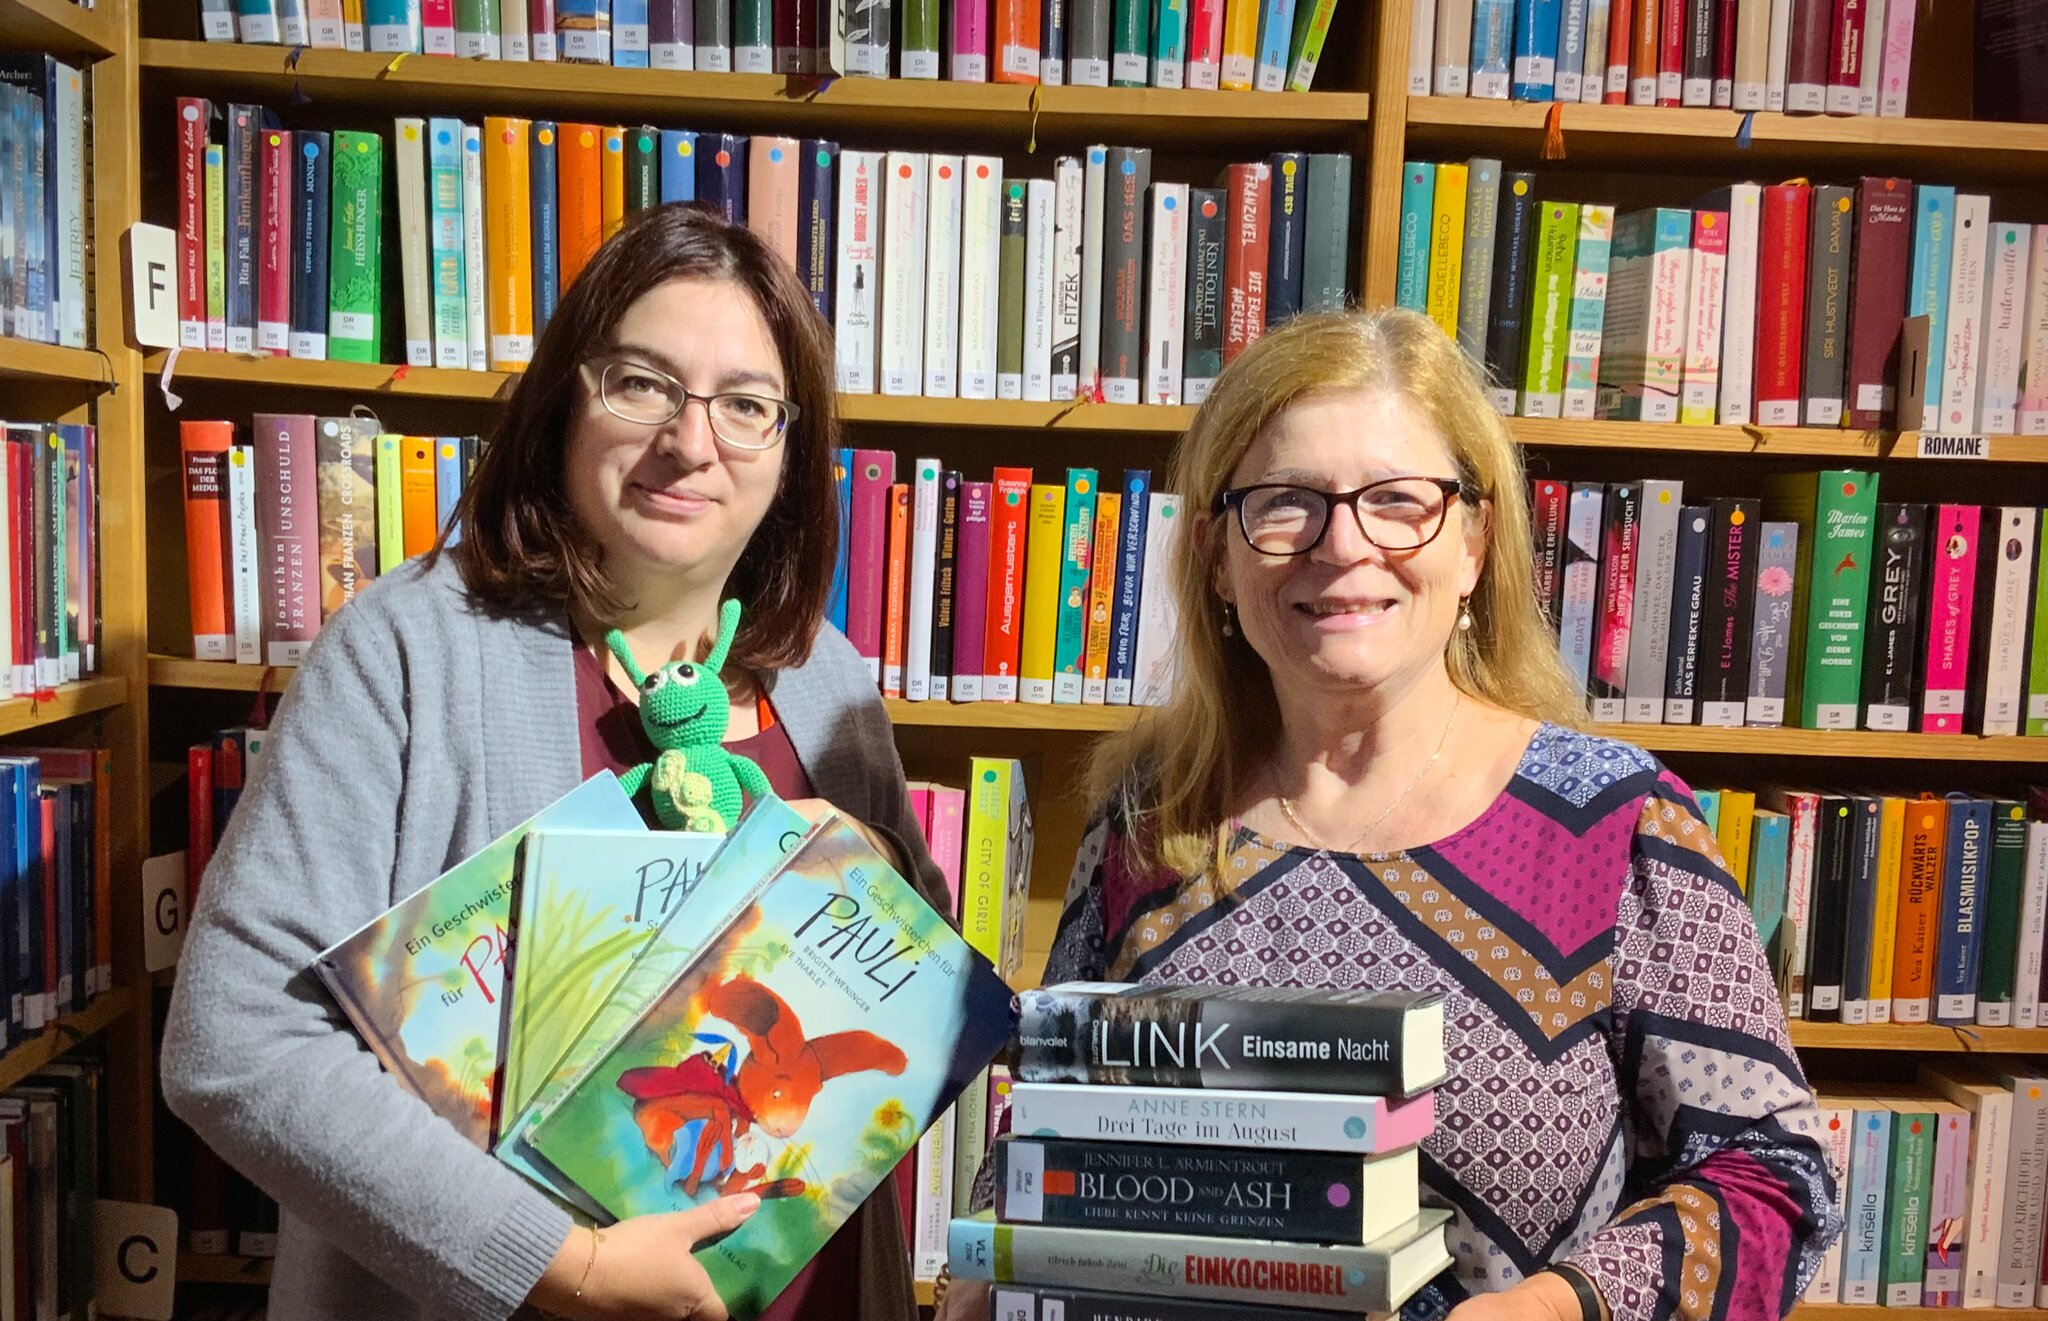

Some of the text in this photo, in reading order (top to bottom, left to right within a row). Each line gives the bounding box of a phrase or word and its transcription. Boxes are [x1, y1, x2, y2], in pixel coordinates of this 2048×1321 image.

[185, 122, 195, 150] Leben
[186, 153, 194, 170] das
[186, 172, 197, 200] spielt
[306, 157, 315, 193] MONDE
[187, 203, 199, 242] Johanna
[238, 128, 252, 285] Rita Falk Funkenflieger
[355, 188, 367, 267] HEISSHUNGER
[854, 178, 868, 242] BRIDGET JONES
[1122, 211, 1133, 243] DAS
[1241, 173, 1258, 246] FRANZOBEL
[1284, 195, 1293, 215] 438
[1470, 186, 1482, 238] PASCALE
[1480, 186, 1494, 238] HUGUES
[69, 211, 82, 281] JEFFREY
[1401, 212, 1418, 306] HOUELLEBECQ
[1436, 213, 1451, 307] HOUELLEBECQ
[1958, 235, 1968, 280] HIMMEL
[148, 261, 166, 310] F
[189, 267, 197, 302] SUSANNE
[1194, 228, 1206, 340] DAS ZWEITE GEDÄCHTNIS
[1203, 242, 1219, 328] KEN FOLLETT
[1248, 272, 1262, 294] DIE
[1447, 263, 1457, 320] SEROTONIN
[1507, 235, 1520, 309] ANDREW MICHAEL
[1823, 200, 1840, 359] SIRI HUSTVEDT DAMALS
[1064, 273, 1079, 325] FITZEK
[1228, 287, 1245, 343] AMERIKAS
[188, 467, 204, 475] DAS
[1924, 437, 1981, 456] ROMANE
[200, 475, 216, 484] DER
[278, 430, 293, 530] UNSCHULD
[341, 425, 354, 569] FRANZEN CROSSROADS
[1827, 510, 1868, 524] Marlon
[1828, 524, 1866, 539] James
[939, 497, 955, 627] Valerie Fritsch Winters Garten
[1000, 521, 1017, 635] Ausgemustert
[1542, 497, 1558, 613] DIE FARBE DER ERFÜLLUNG
[1613, 500, 1635, 653] DAYS DIE FARBE DER SEHNSUCHT
[1726, 525, 1743, 580] MISTER
[275, 543, 289, 630] Jonathan
[291, 543, 304, 630] FRANZEN
[1117, 552, 1136, 664] DAVID BEVOR WIR
[1607, 555, 1620, 613] VINA JACKSON
[1723, 582, 1739, 608] The
[1832, 598, 1850, 606] EINE
[1881, 547, 1901, 661] JAMES GREY
[1575, 617, 1586, 641] DAYS
[1684, 576, 1702, 696] DAS PERFEKTE GRAU
[1722, 616, 1735, 652] James
[1818, 622, 1860, 630] GESCHICHTE
[1829, 610, 1852, 618] KURZE
[1831, 634, 1847, 642] VON
[1942, 566, 1961, 670] SHADES of GREY
[2000, 570, 2016, 672] SHADES GREY
[1820, 658, 1852, 666] MORDEN
[1826, 646, 1851, 654] SIEBEN
[976, 837, 993, 933] CITY OF GIRLS
[1907, 834, 1927, 904] RÜCKWÄRTS
[1924, 846, 1938, 892] WALZER
[155, 888, 179, 936] G
[404, 878, 517, 957] Ein Geschwiste
[848, 867, 956, 978] Ein Geschwisterchen für
[1956, 819, 1980, 984] Vea Kaiser BLASMUSIKPOP
[780, 942, 828, 990] EVE THARLET
[1911, 912, 1927, 982] Vea Kaiser
[441, 987, 464, 1008] für
[803, 945, 871, 1014] BRIGITTE WENINGER
[1020, 1035, 1068, 1048] blanvalet
[1101, 1020, 1232, 1070] LINK
[1243, 1036, 1390, 1061] Einsame Nacht
[969, 1121, 977, 1144] LENA
[1097, 1117, 1298, 1144] Drei Tage im August
[1128, 1098, 1267, 1120] ANNE STERN
[929, 1167, 942, 1196] ZWEI
[1083, 1151, 1285, 1177] JENNIFER ARMENTROUT
[1979, 1104, 1998, 1243] Sophie Kinsella Shopaholic
[2024, 1107, 2047, 1269] DÄMMER UND AUFRUHR
[1080, 1172, 1293, 1211] BLOOD AND ASH
[1085, 1206, 1285, 1228] LIEBE KENNT KEINE GRENZEN
[2010, 1148, 2032, 1269] BODO KIRCHHOFF
[1858, 1193, 1877, 1253] kinsella
[1901, 1196, 1920, 1255] kinsella
[117, 1235, 159, 1284] C
[718, 1244, 746, 1272] VERLAG
[977, 1239, 986, 1267] VLK
[1141, 1251, 1346, 1295] Die EINKOCHBIBEL
